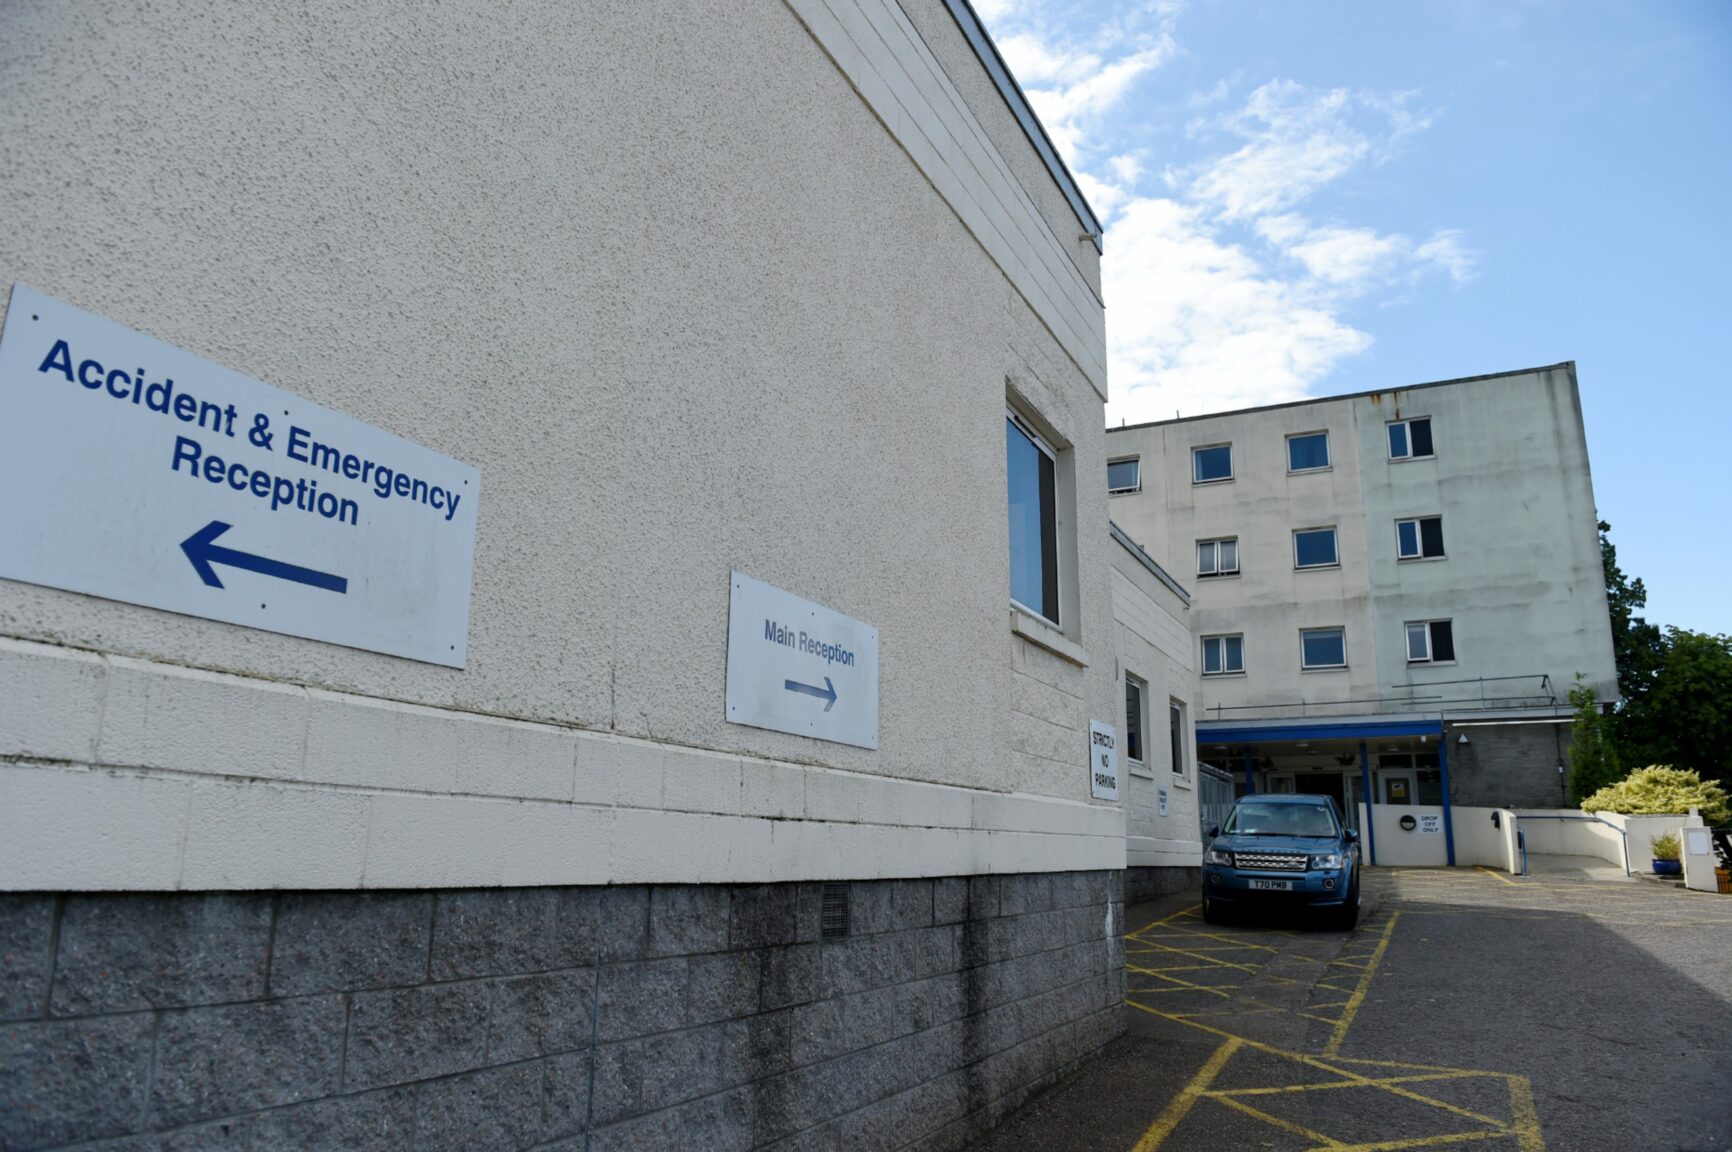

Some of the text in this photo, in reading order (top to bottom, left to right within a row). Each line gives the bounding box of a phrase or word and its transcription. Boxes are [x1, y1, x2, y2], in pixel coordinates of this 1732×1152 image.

[38, 339, 461, 521] Accident & Emergency
[172, 435, 359, 526] Reception
[764, 619, 855, 667] Main Reception
[1092, 731, 1114, 749] STRICTLY
[1101, 754, 1109, 768] NO
[1095, 773, 1116, 789] PARKING
[1254, 880, 1270, 888] T70
